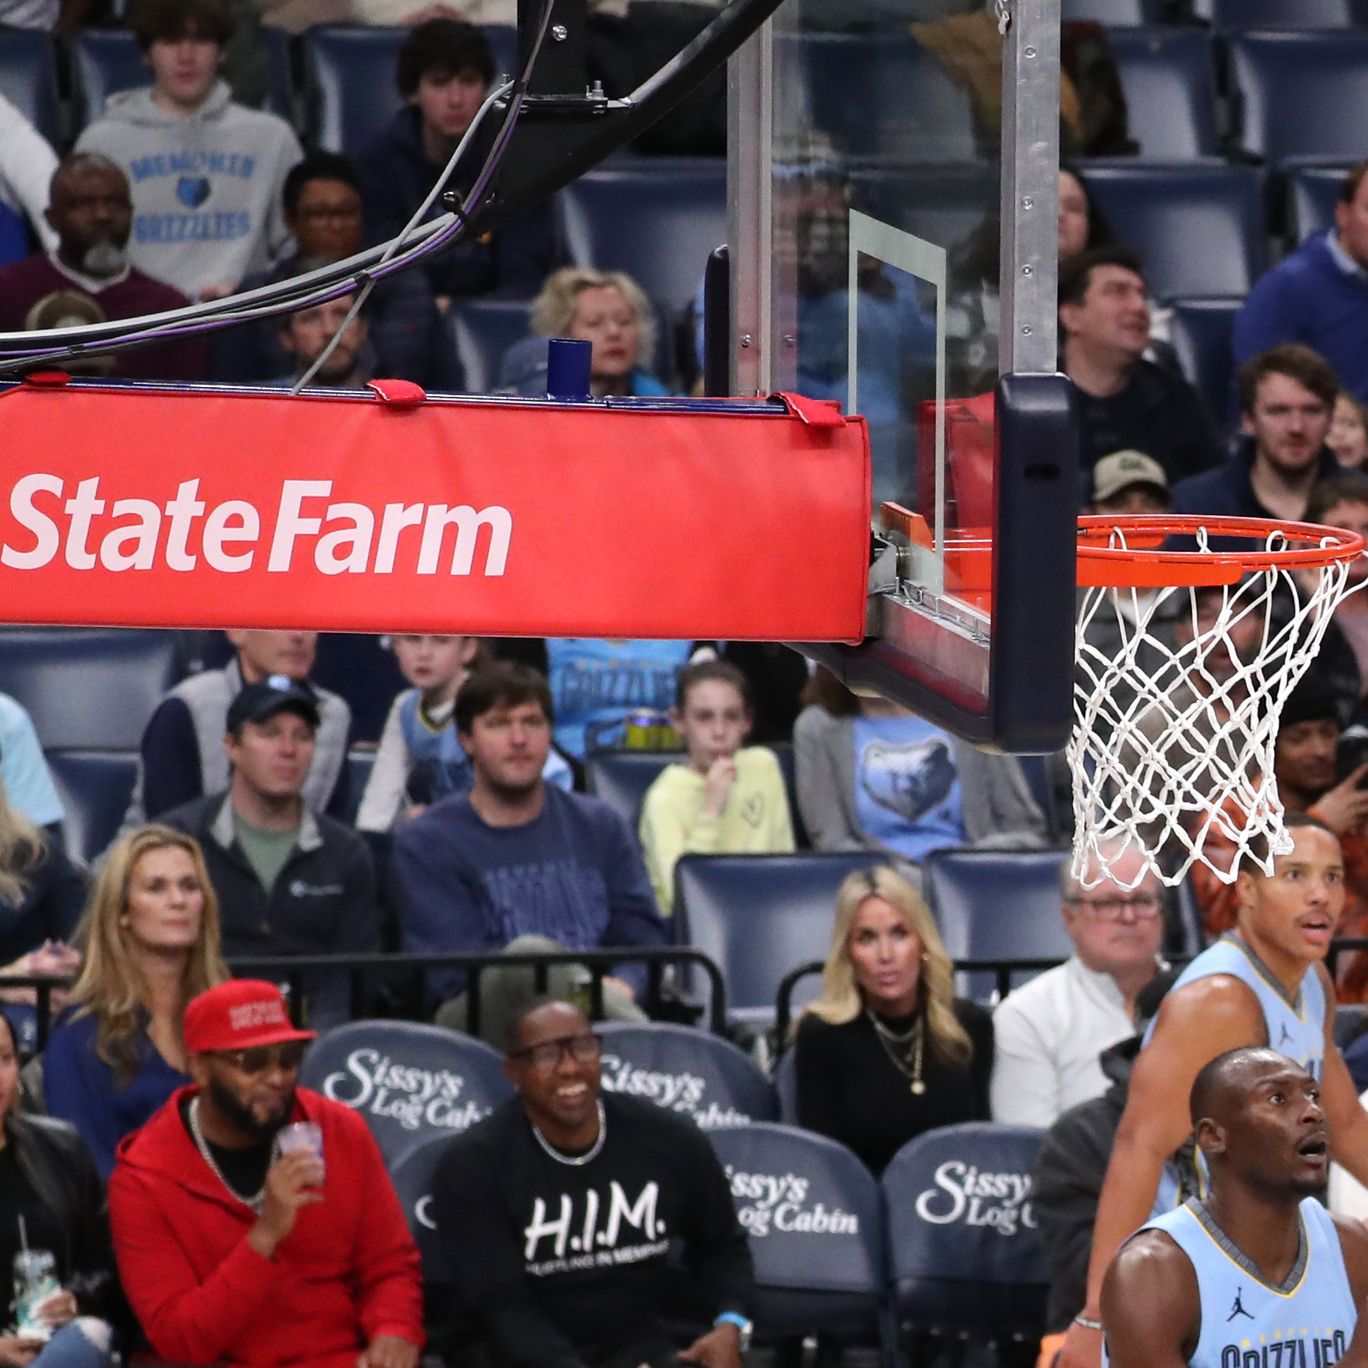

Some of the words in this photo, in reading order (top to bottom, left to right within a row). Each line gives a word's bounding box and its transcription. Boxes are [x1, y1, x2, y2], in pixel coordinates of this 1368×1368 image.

[1, 473, 260, 573] State
[267, 480, 513, 577] Farm
[323, 1048, 464, 1108] Sissy's
[371, 1088, 424, 1130] Log
[426, 1097, 494, 1129] Cab
[524, 1180, 666, 1261] H.I.M.
[738, 1205, 771, 1237] og
[774, 1202, 859, 1235] Cabin
[916, 1160, 1033, 1225] Sissy
[965, 1197, 1019, 1236] Log
